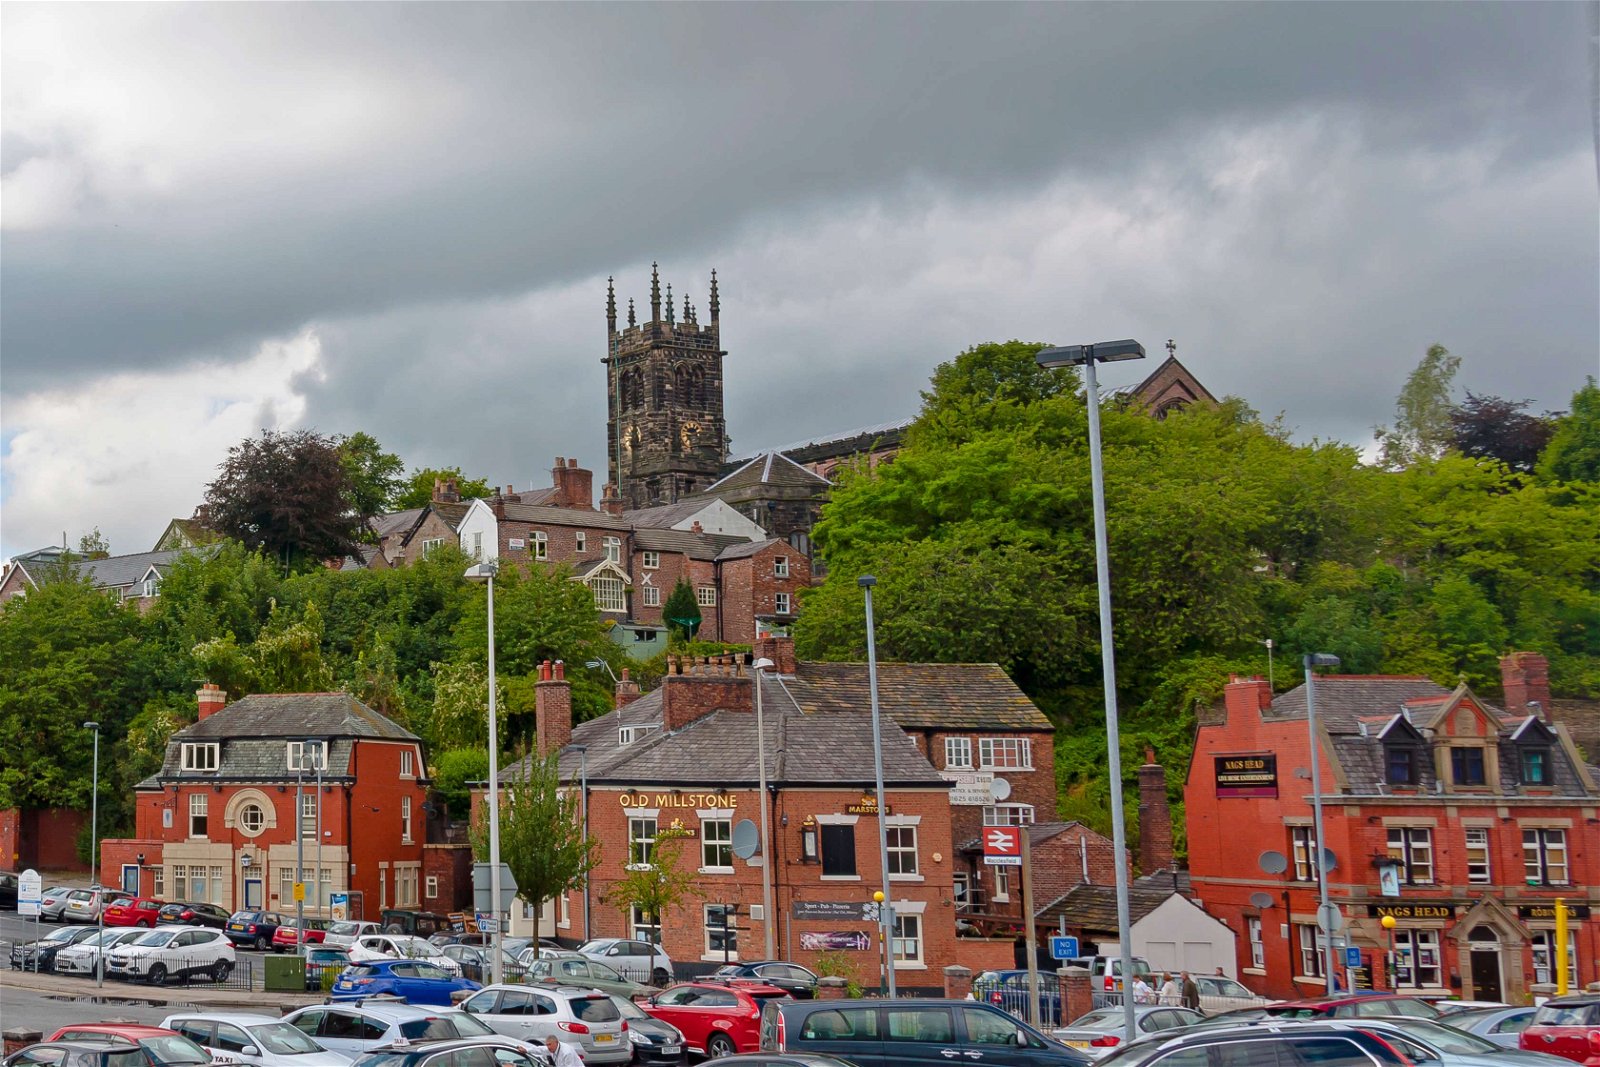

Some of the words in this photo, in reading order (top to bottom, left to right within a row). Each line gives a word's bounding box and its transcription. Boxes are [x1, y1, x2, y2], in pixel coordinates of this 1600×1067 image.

[1225, 760, 1243, 769] NAGS
[1244, 759, 1264, 769] HEAD
[619, 794, 649, 807] OLD
[655, 794, 738, 808] MILLSTONE
[1376, 907, 1411, 916] NAGS
[1414, 906, 1449, 916] HEAD
[215, 1055, 233, 1064] TAXI
